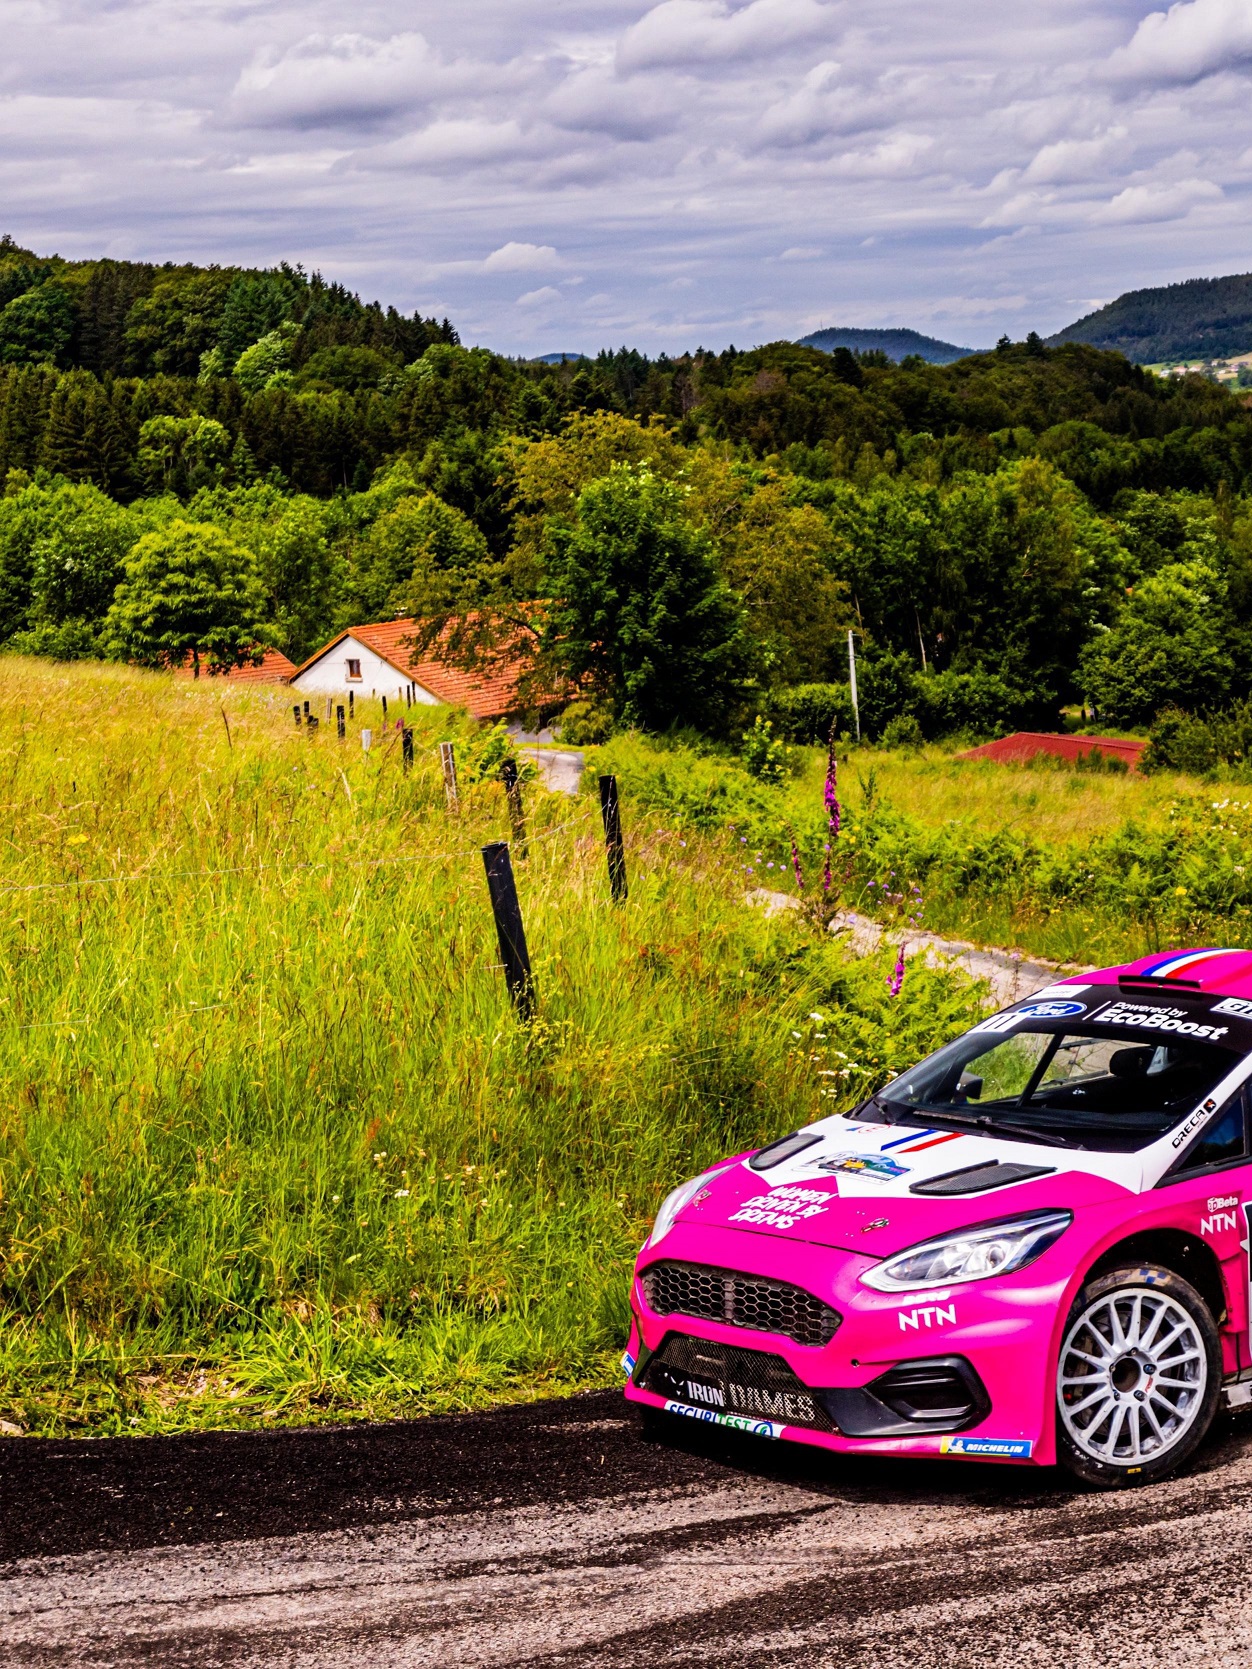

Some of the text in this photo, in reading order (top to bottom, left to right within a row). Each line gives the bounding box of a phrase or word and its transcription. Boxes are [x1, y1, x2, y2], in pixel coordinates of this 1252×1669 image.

[1111, 1001, 1189, 1018] Powered by
[1093, 1008, 1229, 1041] EcoBoost
[1172, 1109, 1205, 1148] ORECA
[767, 1186, 839, 1204] WOMEN
[1201, 1210, 1237, 1236] NTN
[898, 1303, 957, 1332] NTN
[687, 1380, 724, 1407] IRON
[966, 1443, 1024, 1453] MICHELIN
